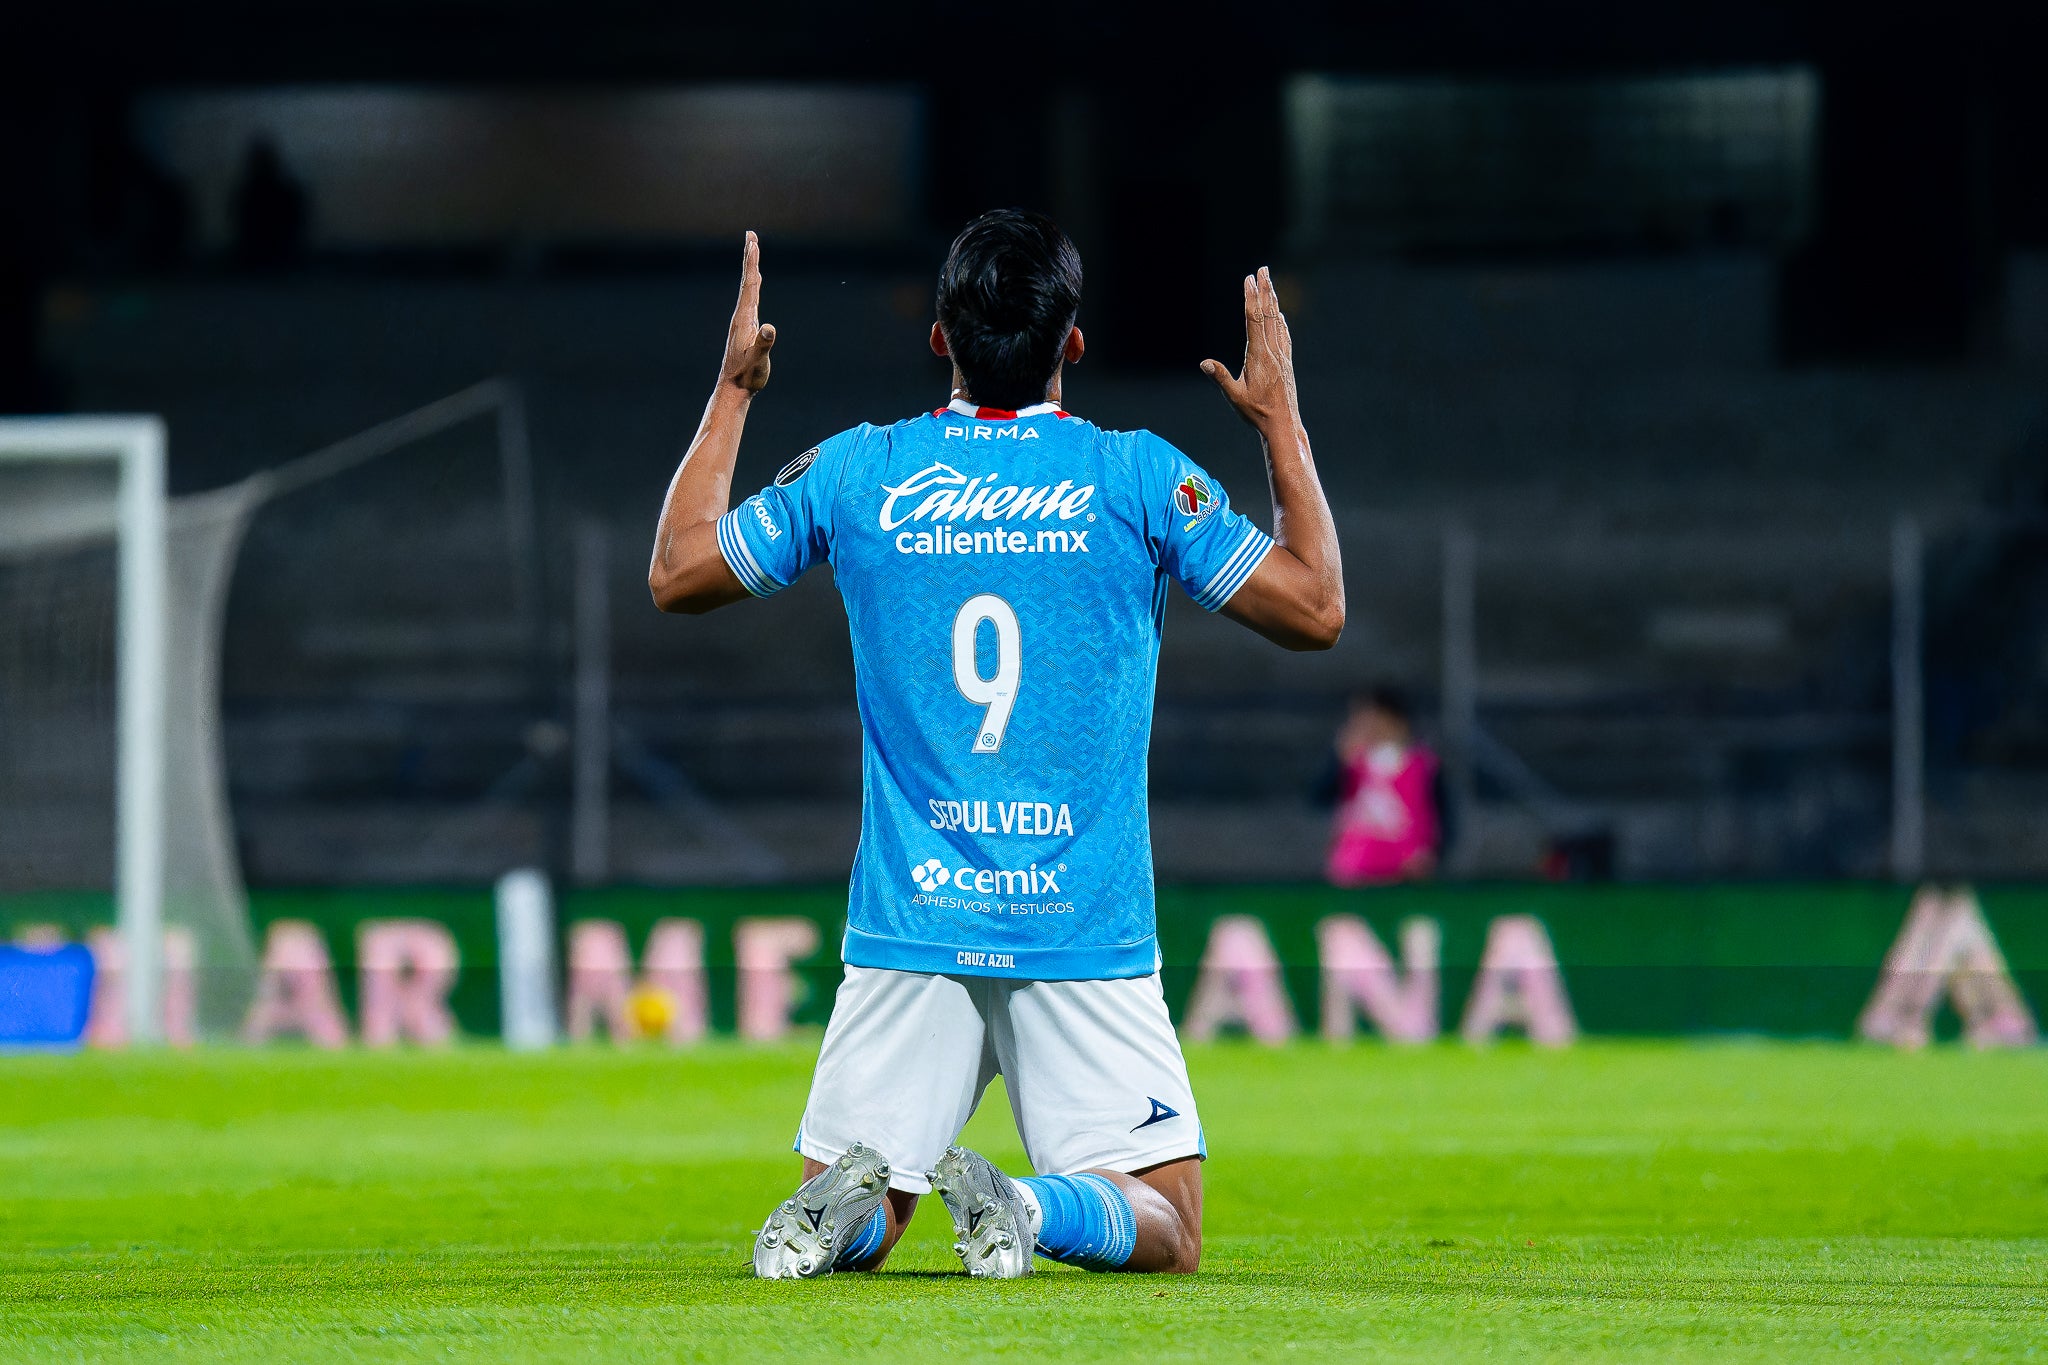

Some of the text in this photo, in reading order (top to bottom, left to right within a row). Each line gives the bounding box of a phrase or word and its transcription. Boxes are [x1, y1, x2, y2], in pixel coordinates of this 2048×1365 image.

[944, 425, 1040, 441] PIRMA
[879, 461, 1095, 532] Caliente
[895, 525, 1090, 554] caliente.mx
[952, 592, 1023, 754] 9
[928, 798, 1074, 836] SEPULVEDA
[953, 863, 1061, 895] cemix
[911, 893, 1075, 915] ADHESIVOS Y ESTUCOS
[956, 951, 1016, 969] CRUZ AZUL
